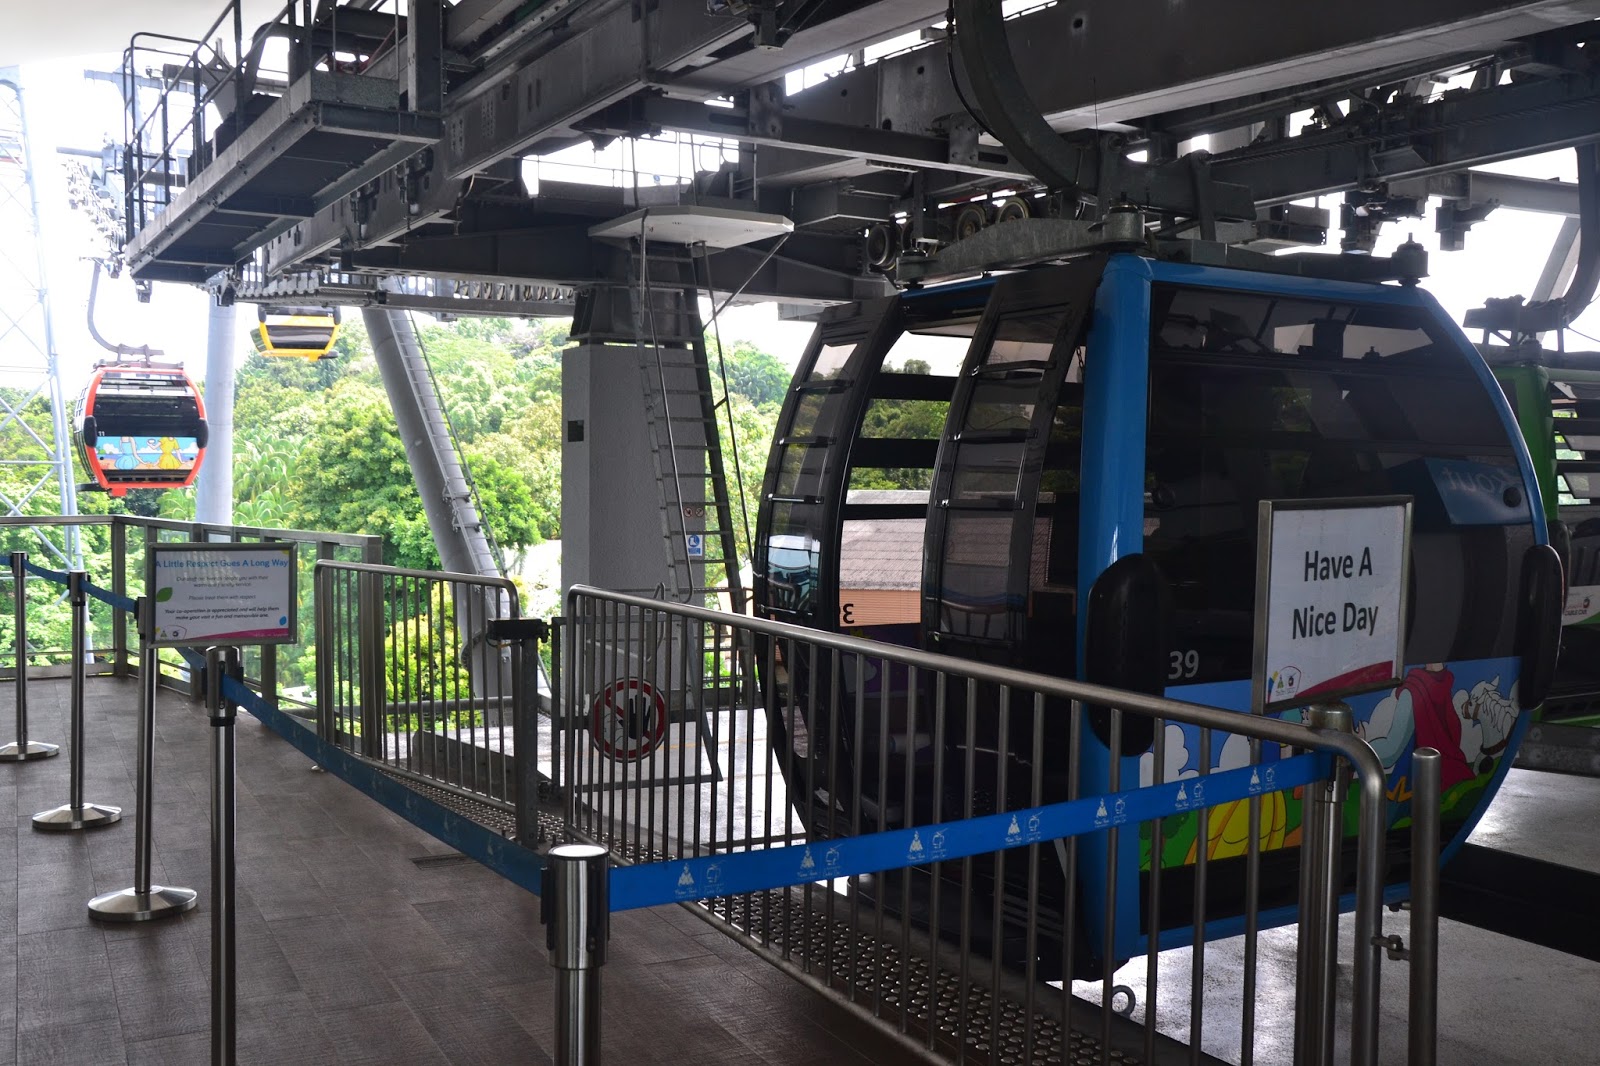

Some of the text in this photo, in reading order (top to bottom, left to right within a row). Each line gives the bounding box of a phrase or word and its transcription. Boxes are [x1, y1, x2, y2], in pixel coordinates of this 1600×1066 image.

[155, 560, 161, 568] A
[164, 560, 184, 568] Little
[220, 559, 240, 567] Goes
[242, 559, 250, 567] A
[251, 559, 270, 568] Long
[271, 559, 288, 568] Way
[1304, 546, 1373, 582] Have A
[1292, 602, 1379, 640] Nice Day
[1168, 649, 1199, 680] 39
